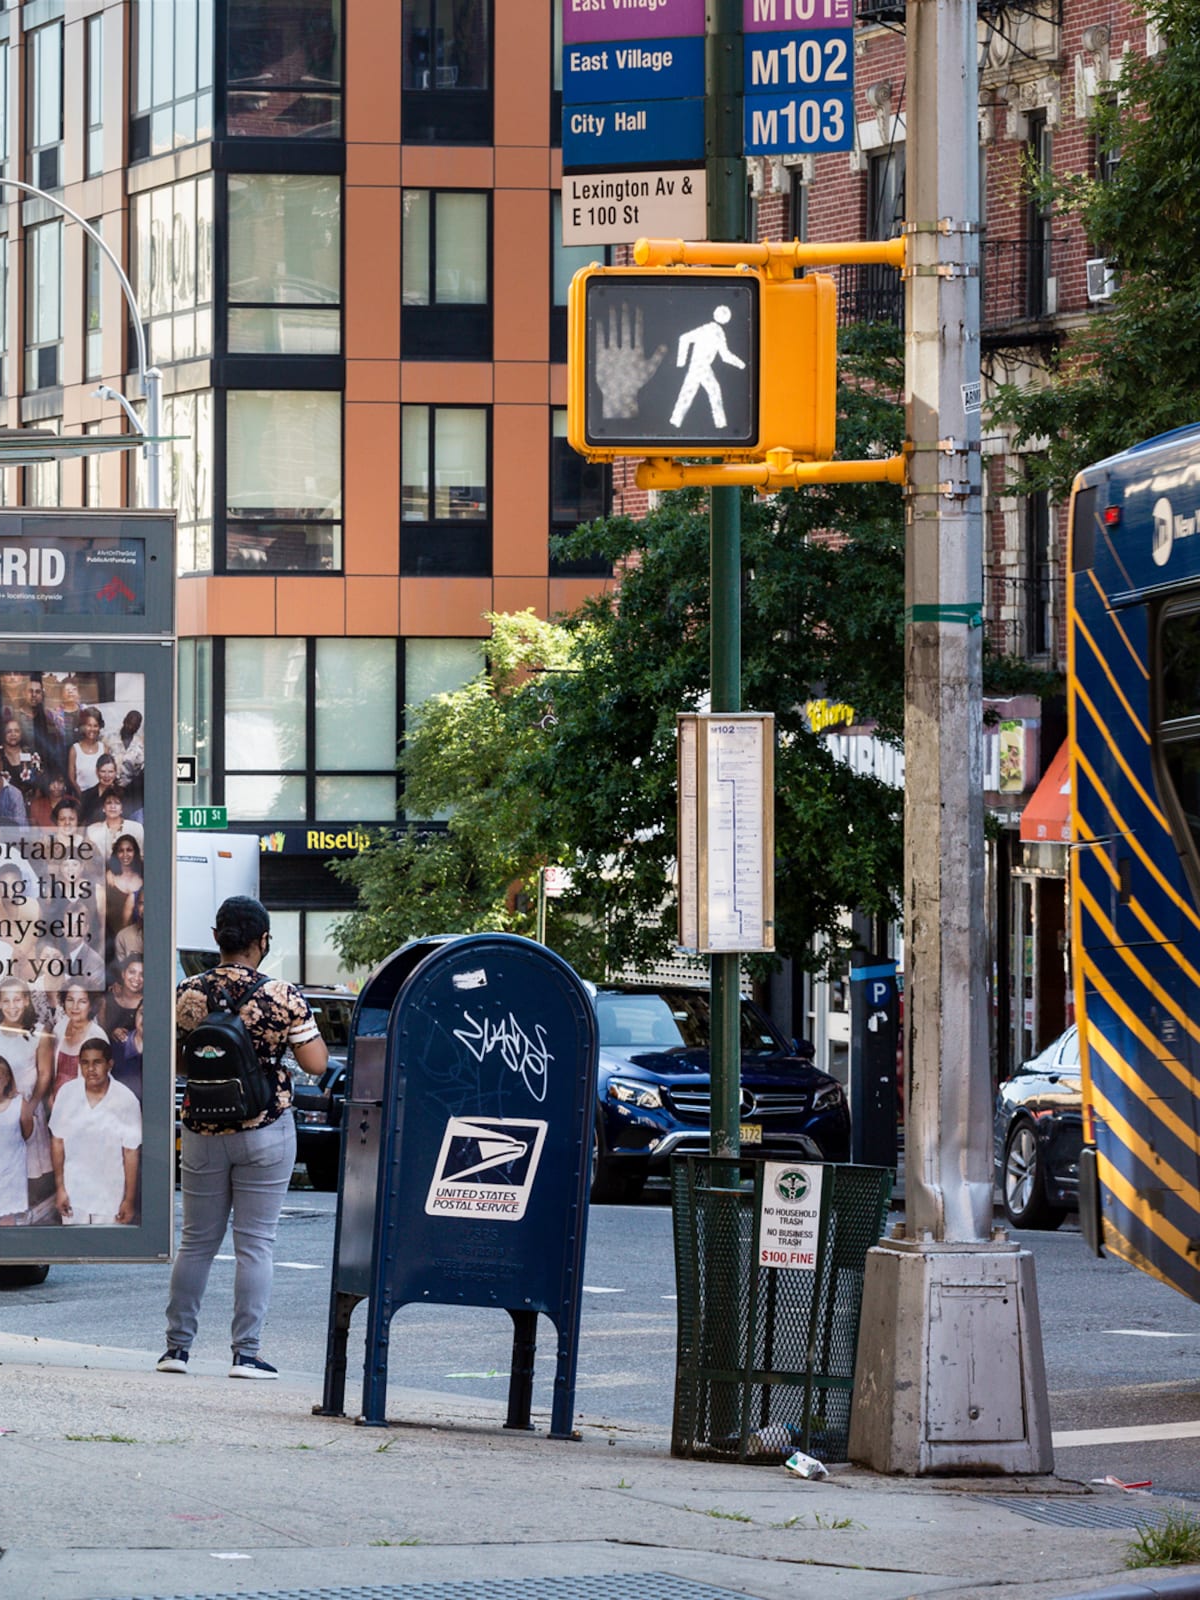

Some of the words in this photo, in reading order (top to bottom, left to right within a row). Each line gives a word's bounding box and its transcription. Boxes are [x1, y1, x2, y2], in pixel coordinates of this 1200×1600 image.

[570, 51, 608, 72] East
[616, 50, 673, 72] Village
[751, 38, 848, 86] M102
[570, 113, 605, 137] City
[615, 111, 647, 132] Hall
[751, 98, 845, 146] M103
[572, 179, 649, 202] Lexington
[655, 177, 675, 196] Av
[681, 176, 693, 195] &
[572, 208, 581, 226] E
[588, 206, 617, 225] 100
[623, 206, 639, 224] St
[37, 592, 63, 601] citywide
[177, 809, 183, 826] E
[189, 809, 207, 826] 101
[211, 809, 221, 821] St
[38, 873, 92, 900] this
[29, 959, 92, 983] you.
[873, 982, 887, 1003] P
[436, 1188, 478, 1199] UNITED
[479, 1190, 517, 1201] STATES
[433, 1200, 473, 1211] POSTAL
[475, 1202, 519, 1213] SERVICE
[775, 1208, 817, 1218] HOUSEHOLD
[779, 1217, 803, 1226] TRASH
[767, 1228, 777, 1236] NO
[779, 1229, 813, 1239] BUSINESS
[778, 1238, 801, 1247] TRASH
[761, 1250, 787, 1263] $100
[790, 1252, 814, 1264] FINE
